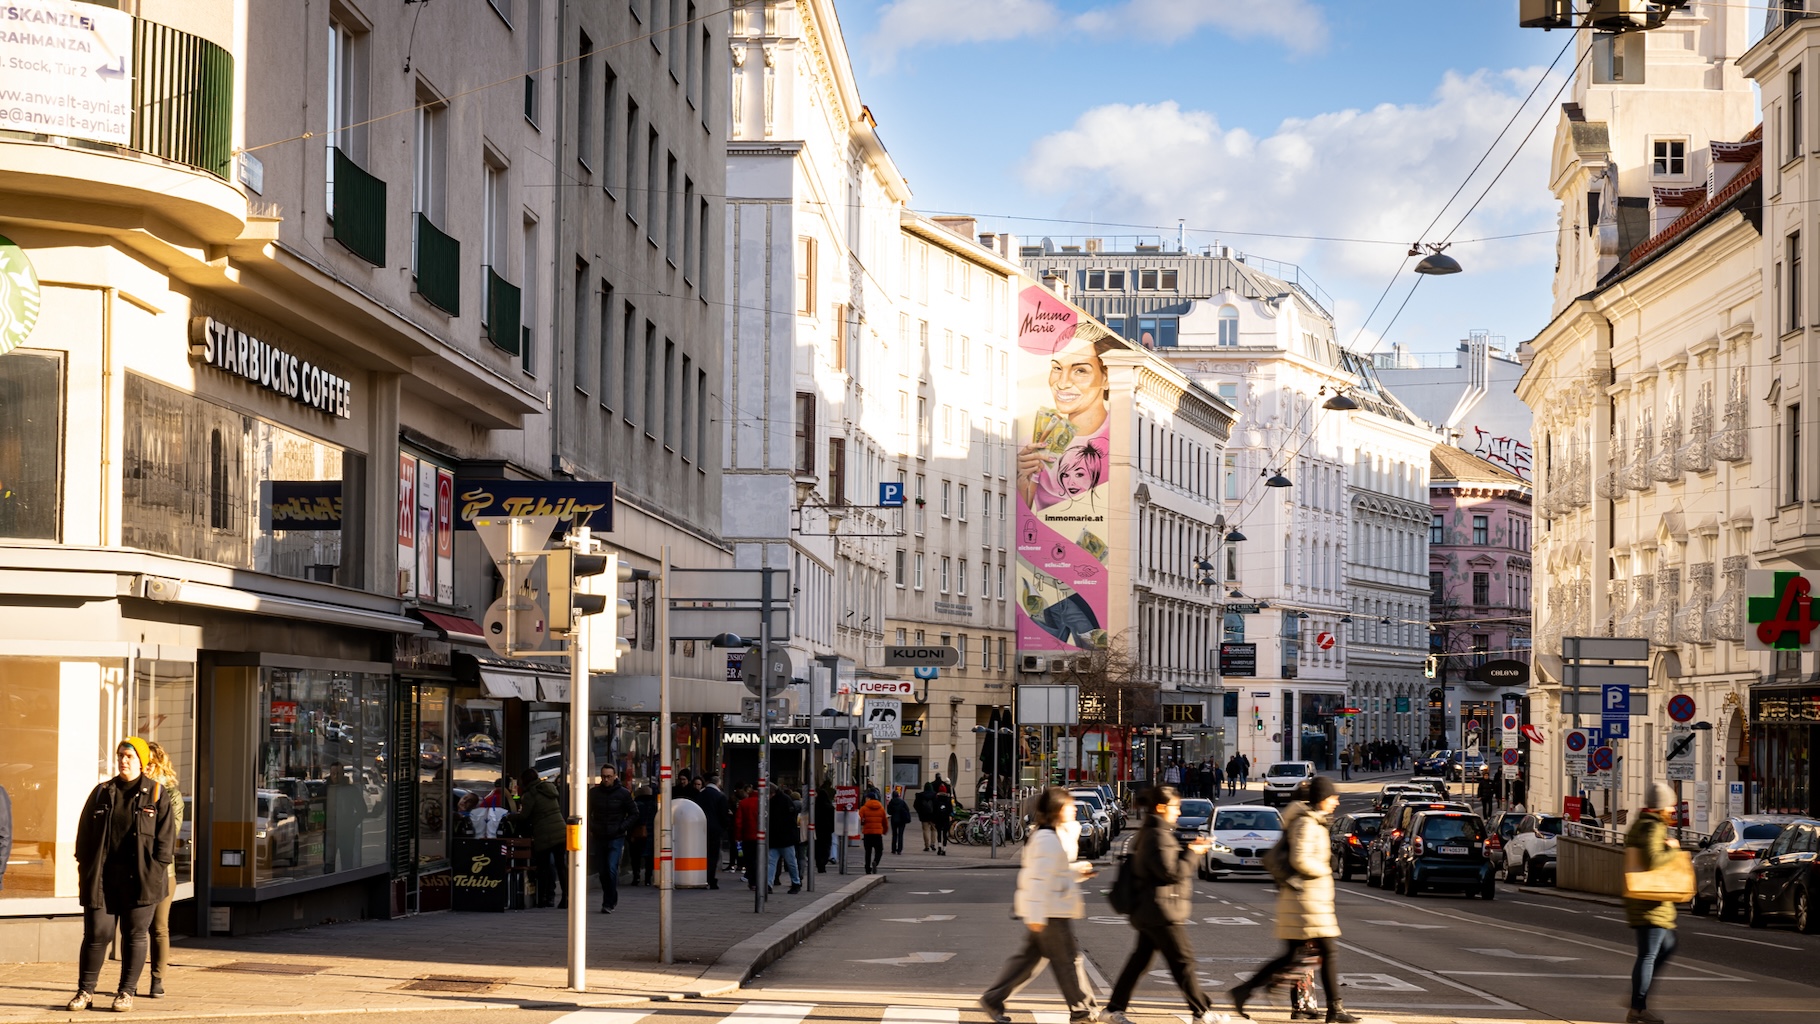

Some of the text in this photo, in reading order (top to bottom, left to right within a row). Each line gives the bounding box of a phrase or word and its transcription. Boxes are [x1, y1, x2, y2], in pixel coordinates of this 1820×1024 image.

[9, 57, 52, 74] Stock,
[80, 66, 87, 77] 2
[1035, 301, 1071, 322] Immo
[1019, 313, 1056, 338] Marie
[204, 316, 351, 420] STARBUCKS COFFEE
[885, 485, 897, 500] P
[1045, 514, 1104, 523] immomarie.at
[893, 649, 945, 659] KUONI
[1490, 669, 1519, 677] COLONO
[860, 682, 897, 692] ruefa
[1607, 691, 1623, 709] P
[453, 875, 503, 888] Tchibo
